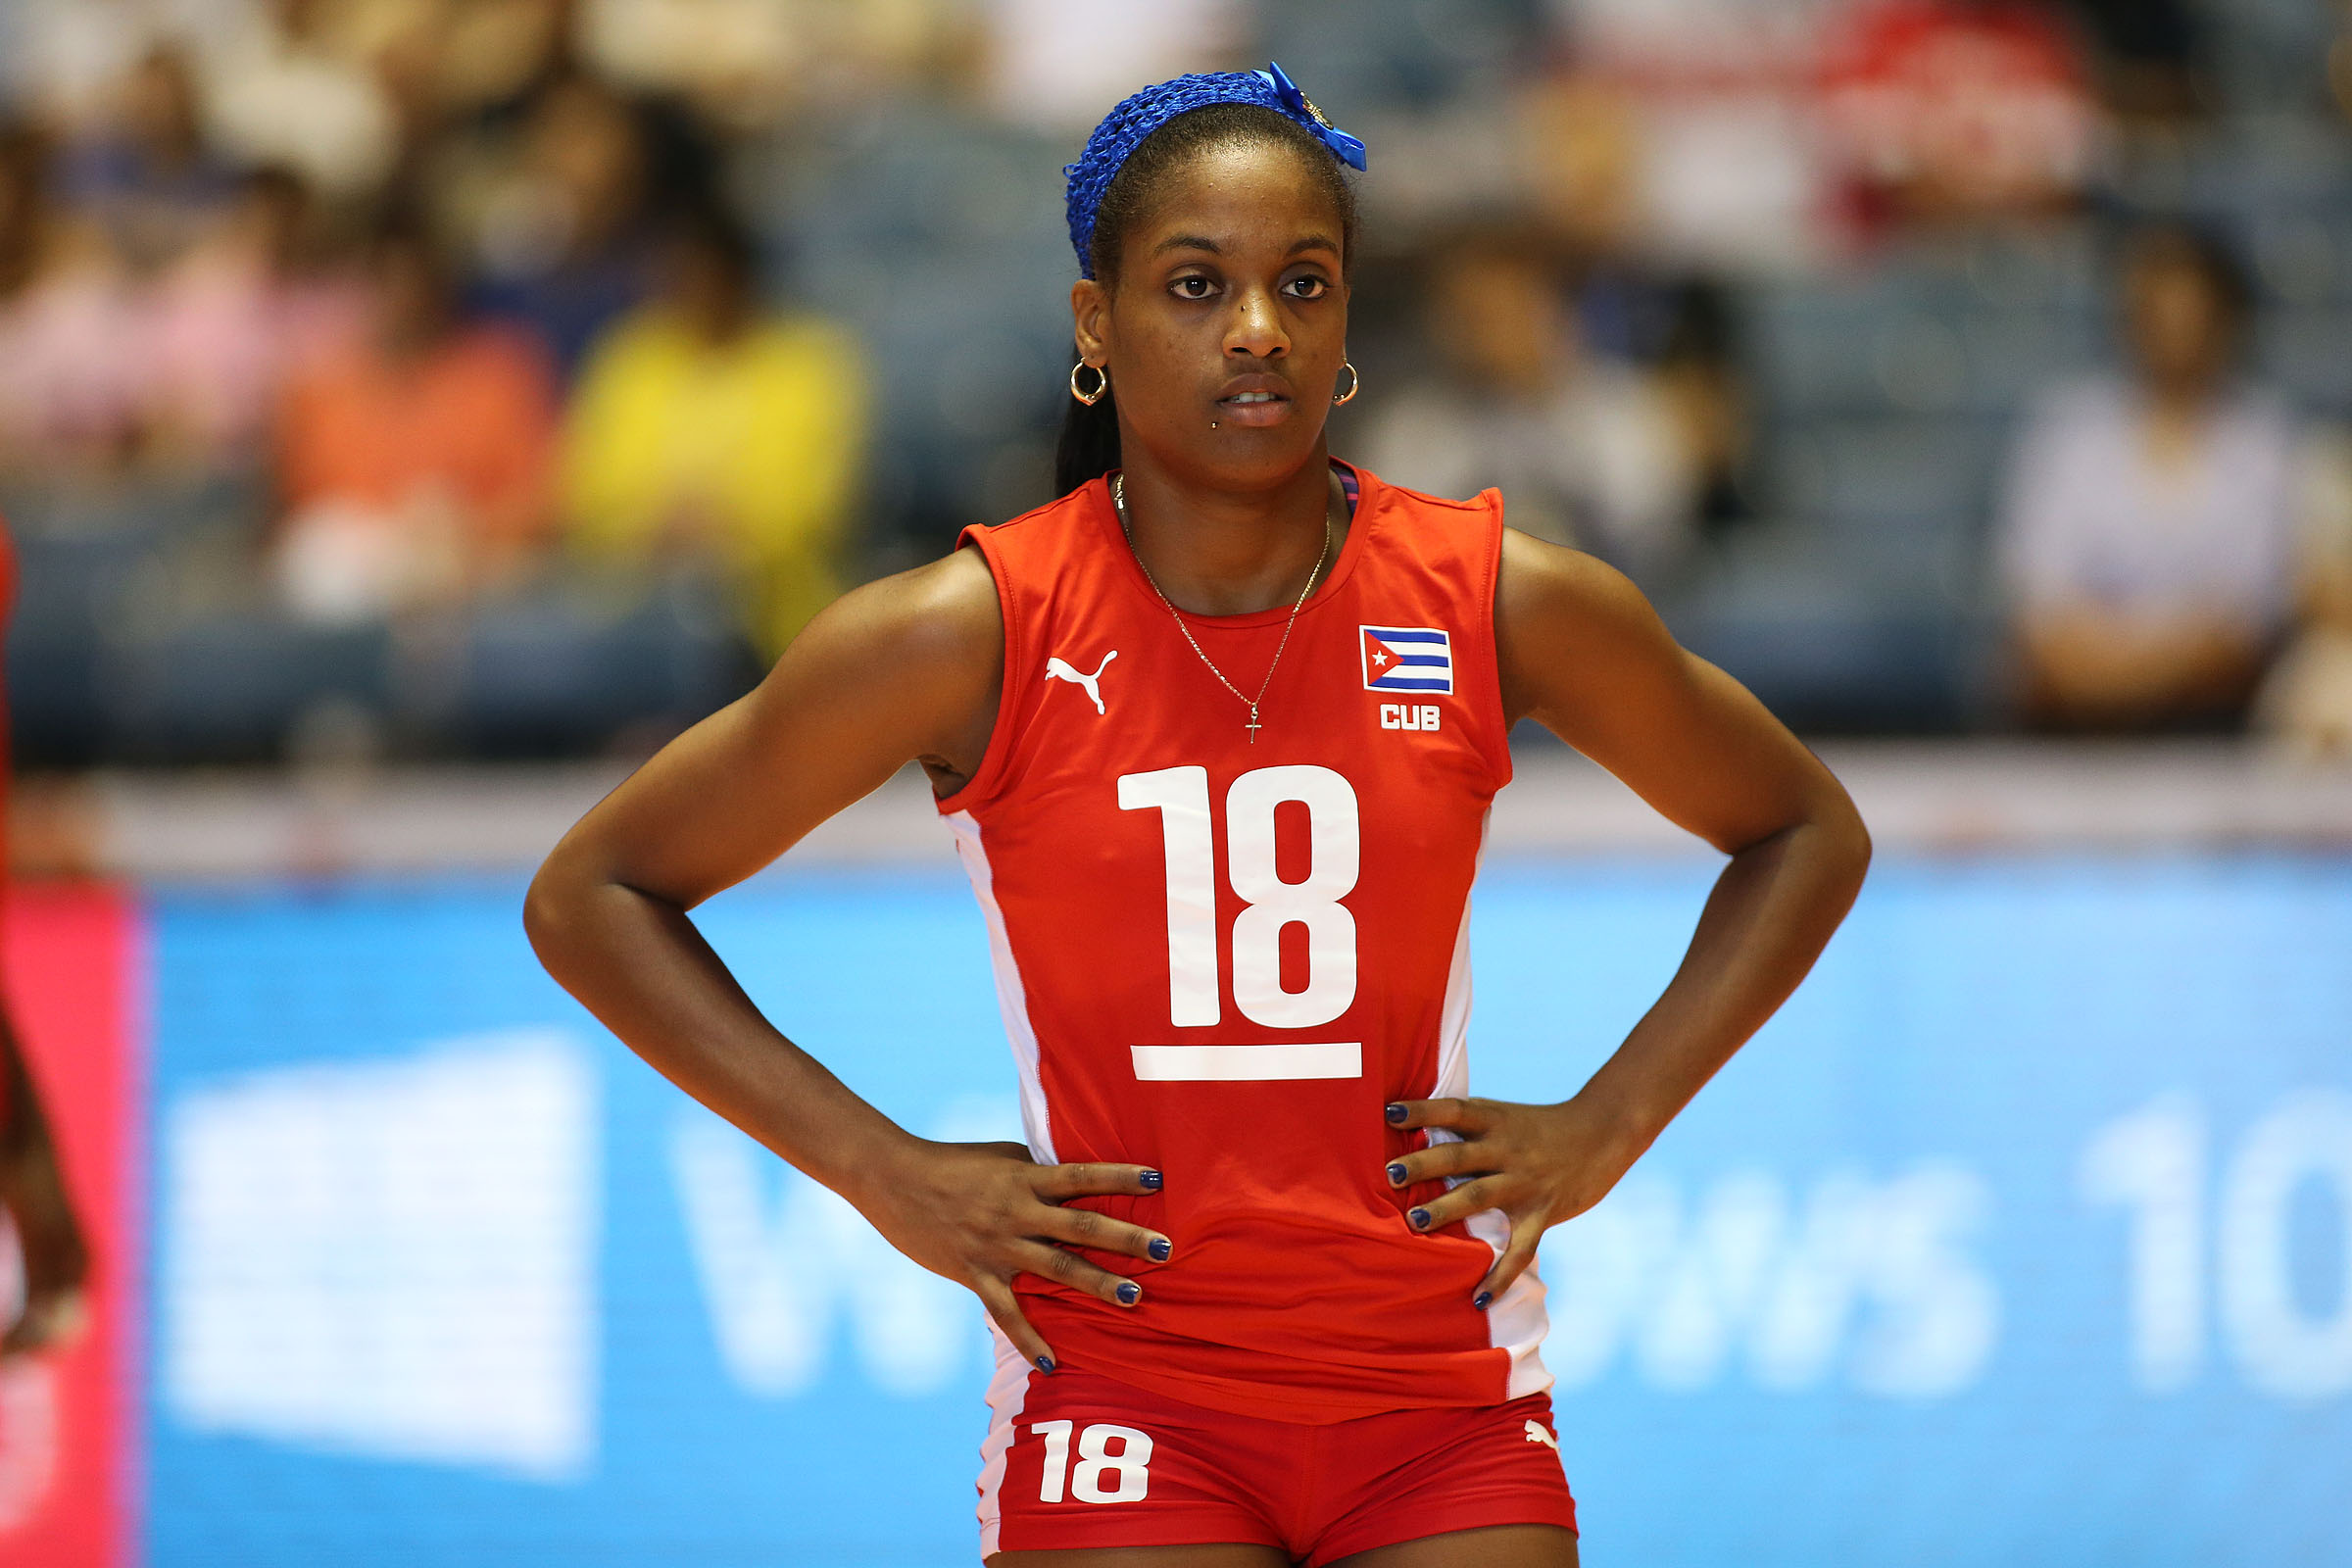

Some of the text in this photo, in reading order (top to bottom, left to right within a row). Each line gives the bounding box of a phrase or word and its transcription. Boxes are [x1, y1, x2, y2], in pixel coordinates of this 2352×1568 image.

[1380, 704, 1441, 731] CUB
[1117, 764, 1360, 1029] 18
[1031, 1419, 1153, 1504] 18
